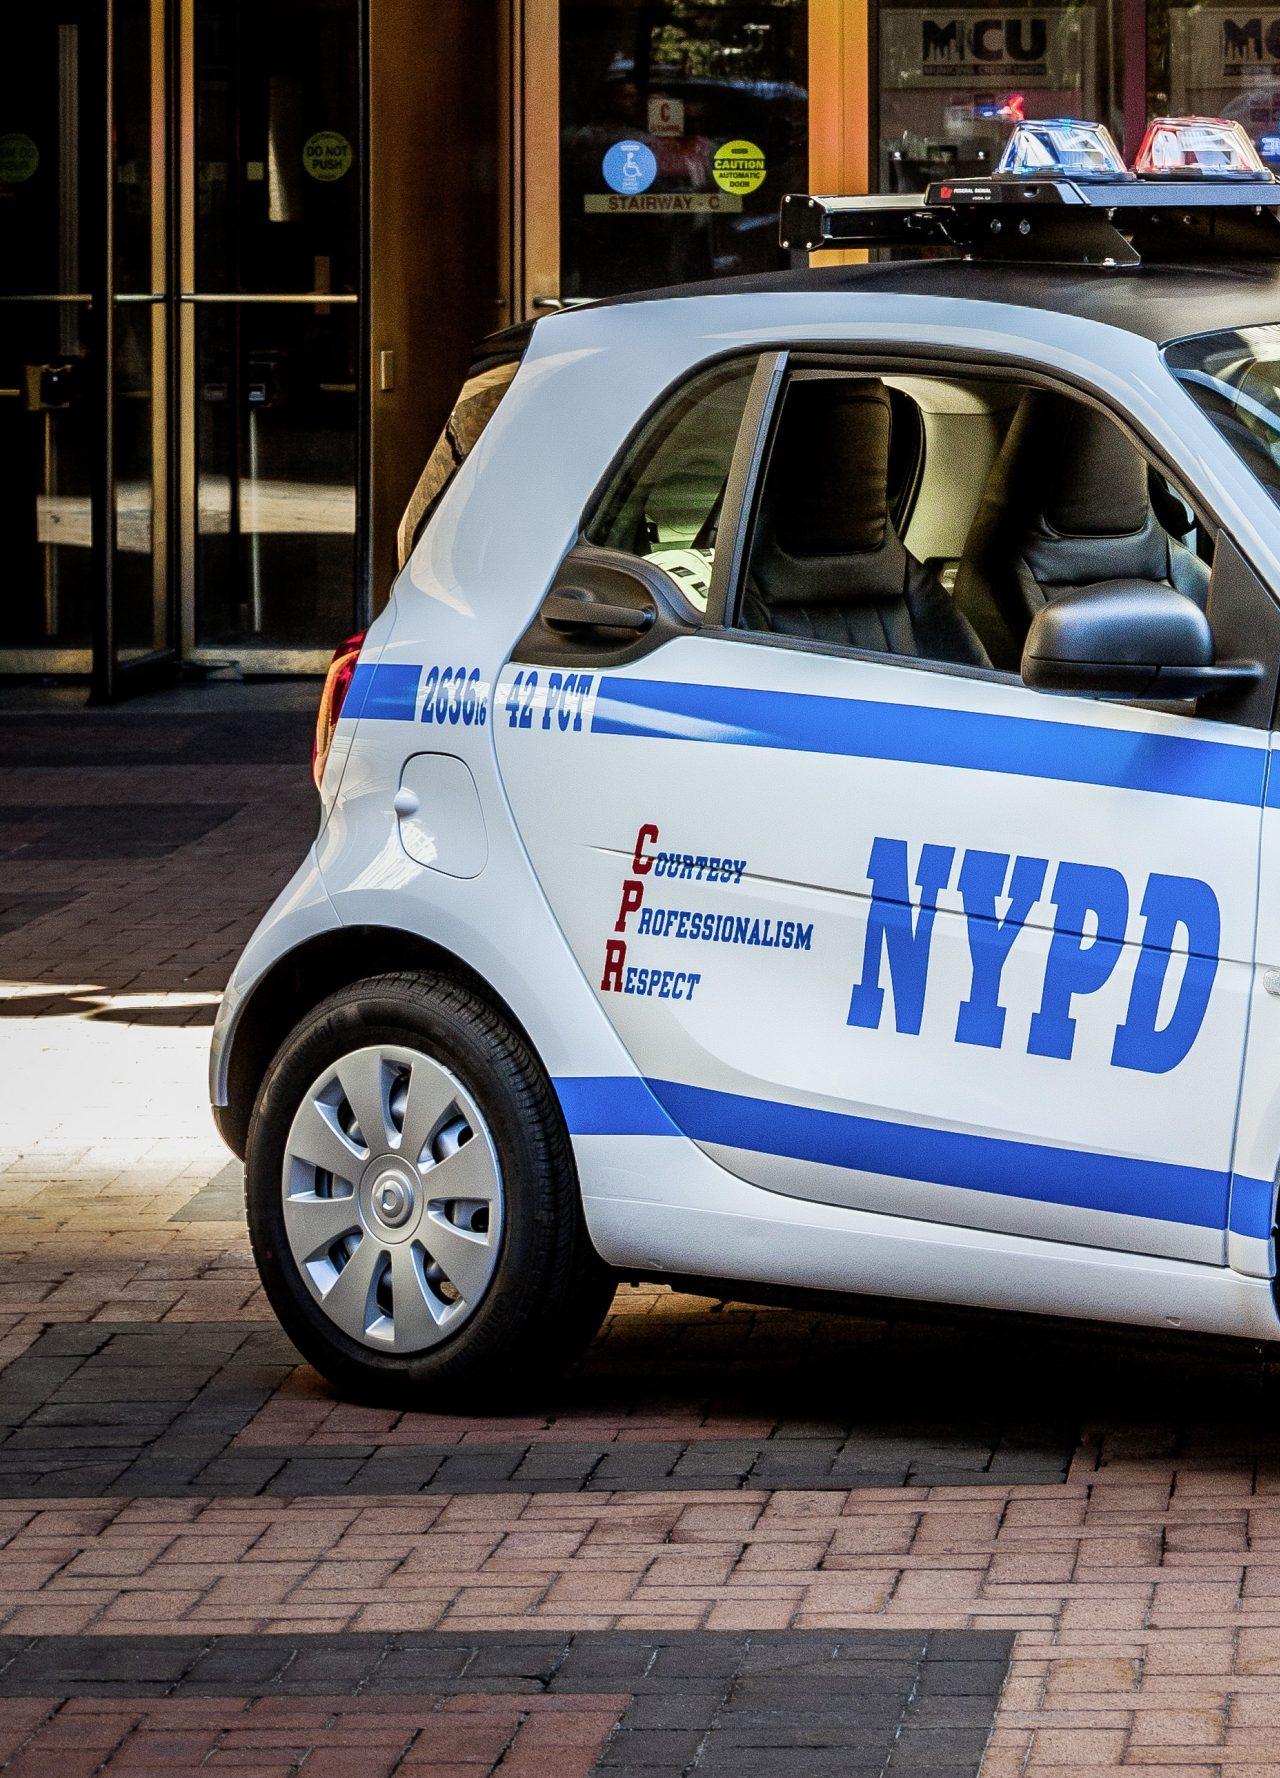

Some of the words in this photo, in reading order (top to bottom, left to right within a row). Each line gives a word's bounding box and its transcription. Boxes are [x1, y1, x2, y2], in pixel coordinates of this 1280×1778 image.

[922, 19, 1047, 61] MCU
[307, 146, 323, 156] DO
[326, 145, 348, 156] NOT
[312, 159, 343, 169] PUSH
[714, 160, 764, 169] CAUTION
[608, 196, 693, 210] STAIRWAY
[708, 195, 720, 210] C
[505, 671, 538, 728] 42
[542, 673, 594, 732] PCT
[614, 880, 814, 950] PROFESSIONALISM
[600, 939, 701, 1000] RESPECT
[846, 836, 1221, 1074] NYPD
